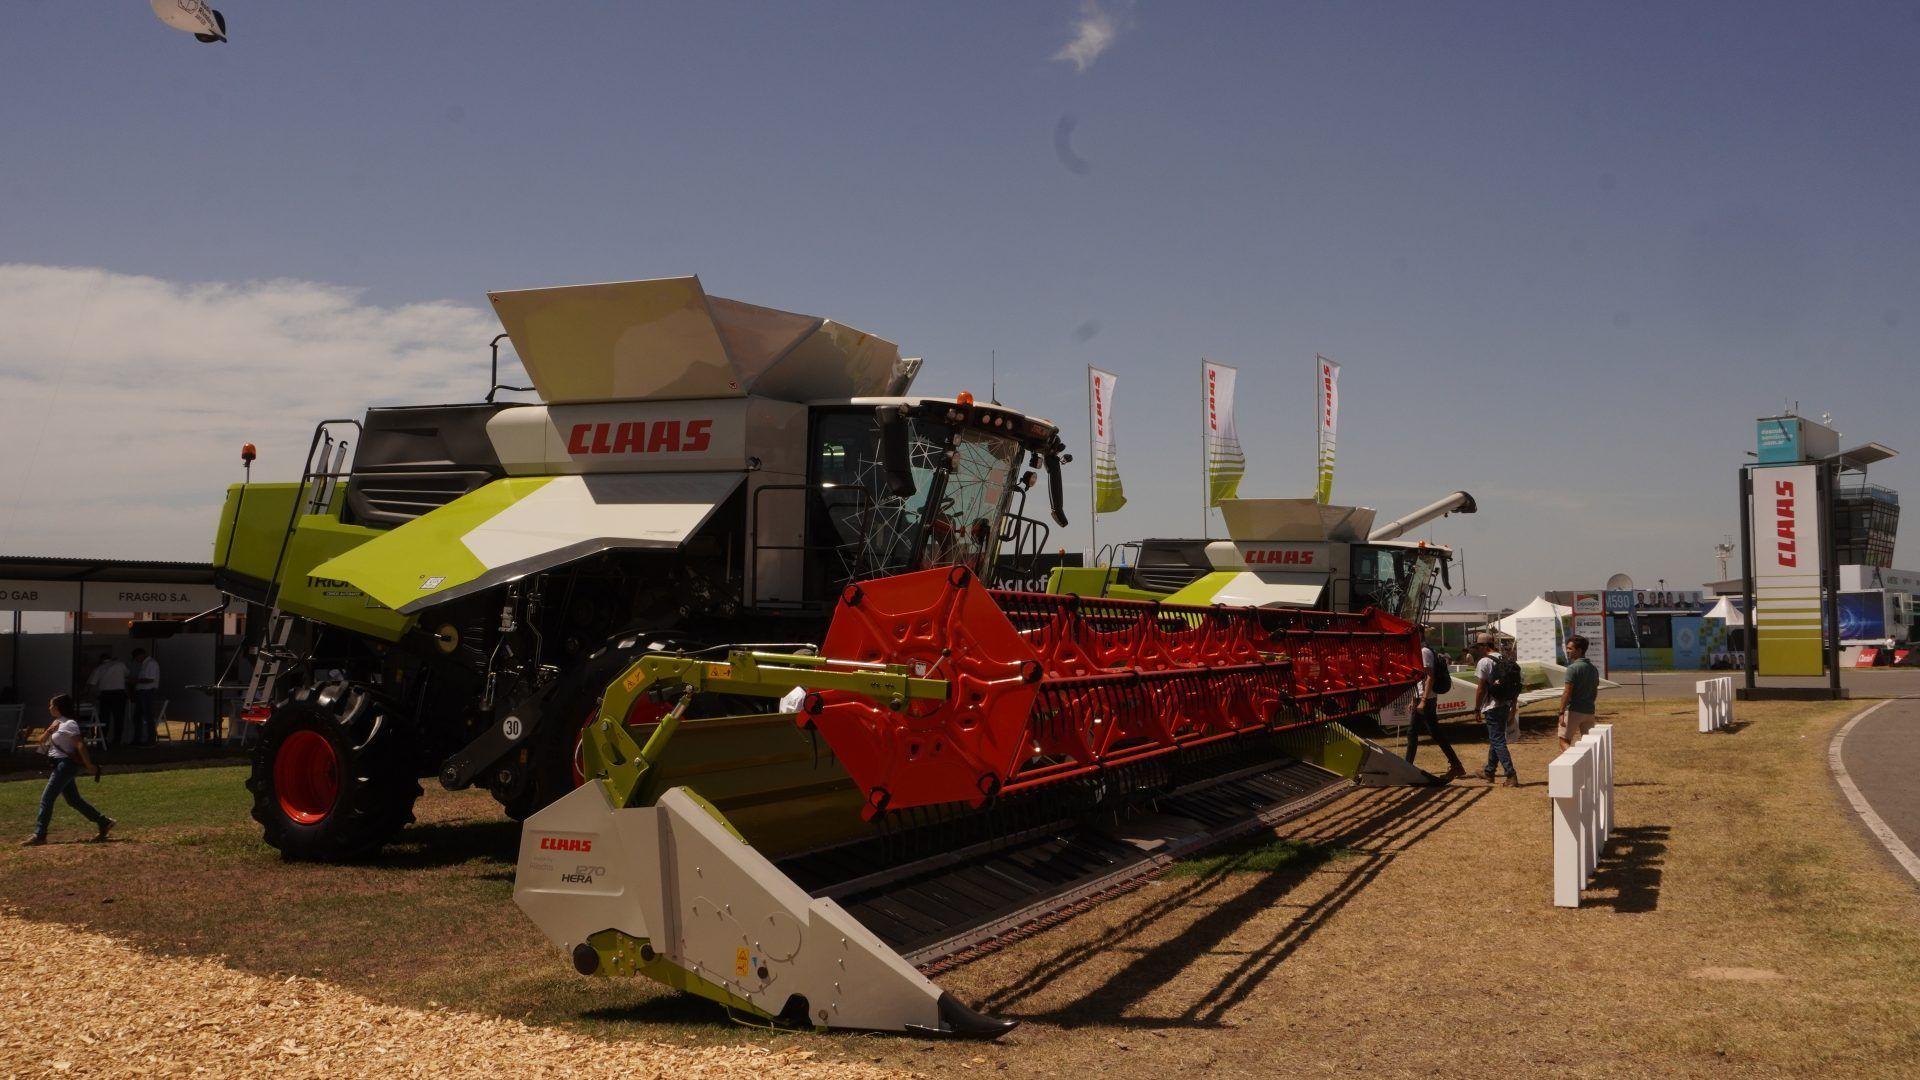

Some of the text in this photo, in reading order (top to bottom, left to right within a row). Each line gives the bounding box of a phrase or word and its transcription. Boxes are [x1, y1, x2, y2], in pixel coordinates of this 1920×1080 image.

[1209, 369, 1217, 431] CLAAS
[1323, 364, 1332, 427] CLAAS
[1094, 375, 1104, 437] CLAAS
[567, 419, 713, 455] CLAAS
[1775, 480, 1797, 568] CLAAS
[1244, 550, 1314, 564] CLAAS
[11, 591, 39, 601] GAB
[118, 592, 191, 603] FRAGRO S.A.
[1437, 700, 1466, 709] CLAAS
[506, 720, 519, 736] 30
[541, 837, 592, 852] CLAAS
[561, 874, 593, 884] HERA
